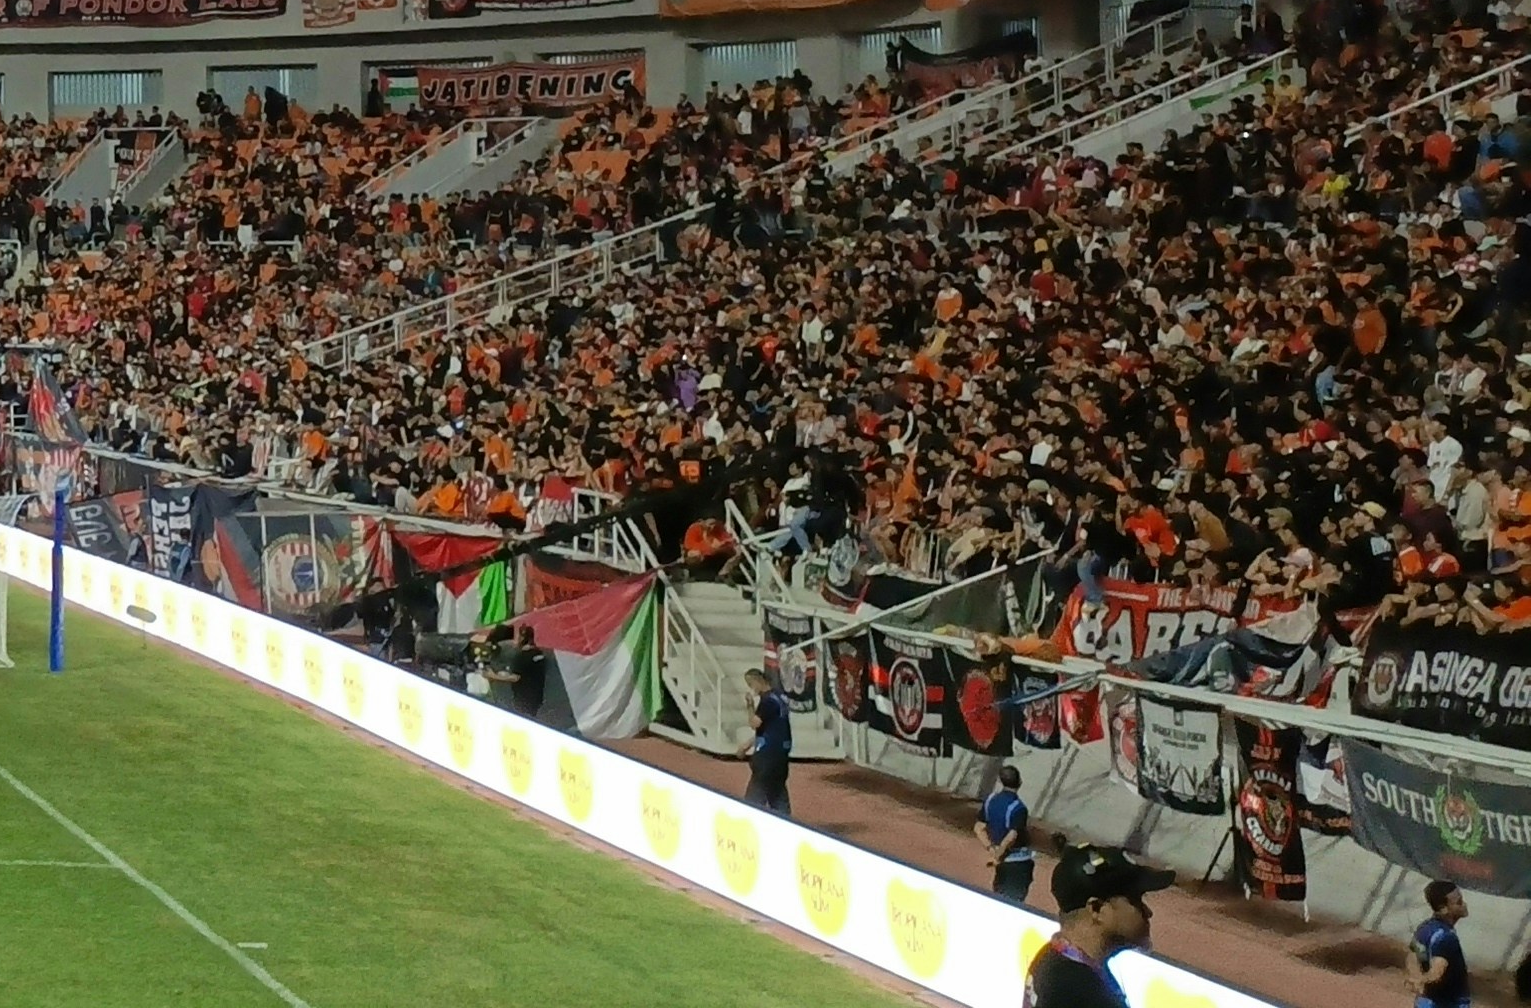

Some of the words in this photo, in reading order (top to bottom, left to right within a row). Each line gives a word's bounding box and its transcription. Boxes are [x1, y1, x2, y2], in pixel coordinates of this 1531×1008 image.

[422, 69, 635, 103] JATIBENING
[1157, 587, 1182, 608] THE
[1362, 771, 1439, 826] SOUTH
